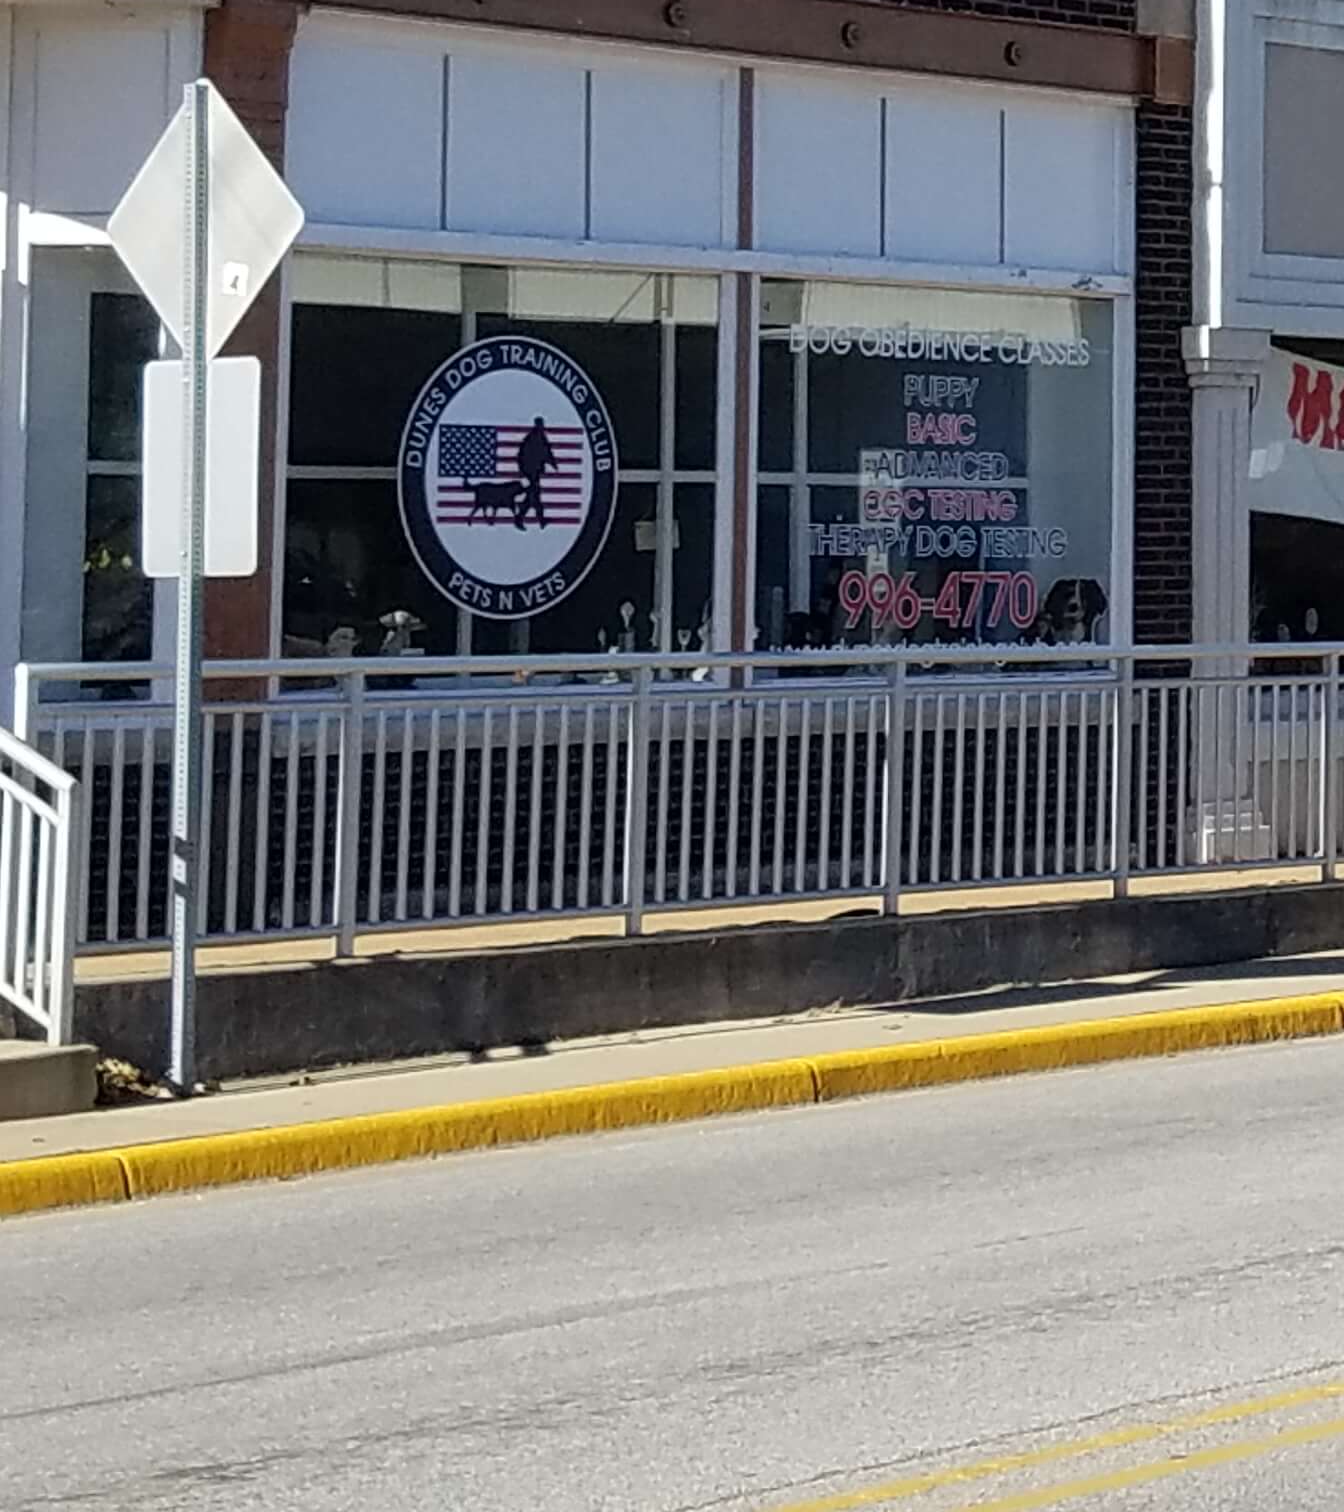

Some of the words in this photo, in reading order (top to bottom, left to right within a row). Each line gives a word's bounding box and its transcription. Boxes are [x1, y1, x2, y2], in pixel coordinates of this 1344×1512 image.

[789, 323, 852, 356] DOG
[858, 327, 994, 364] OBEDIENCE
[998, 336, 1091, 367] CLASSES
[405, 387, 449, 469] DUNES
[445, 348, 495, 391] DOG
[499, 344, 590, 405] TRAINING
[585, 408, 613, 473] CLUB
[903, 374, 980, 409] PUPPY
[906, 411, 977, 445] BASIC
[874, 451, 1010, 481] ADVANCED
[863, 489, 925, 522] CGC
[927, 489, 1018, 522] TESTING
[808, 523, 915, 557] THERAPY
[915, 524, 977, 558] DOG
[980, 526, 1069, 558] TESTING
[449, 571, 492, 609] PETS
[499, 594, 514, 611] N
[522, 571, 567, 609] VETS
[838, 570, 1038, 629] 996-4770
